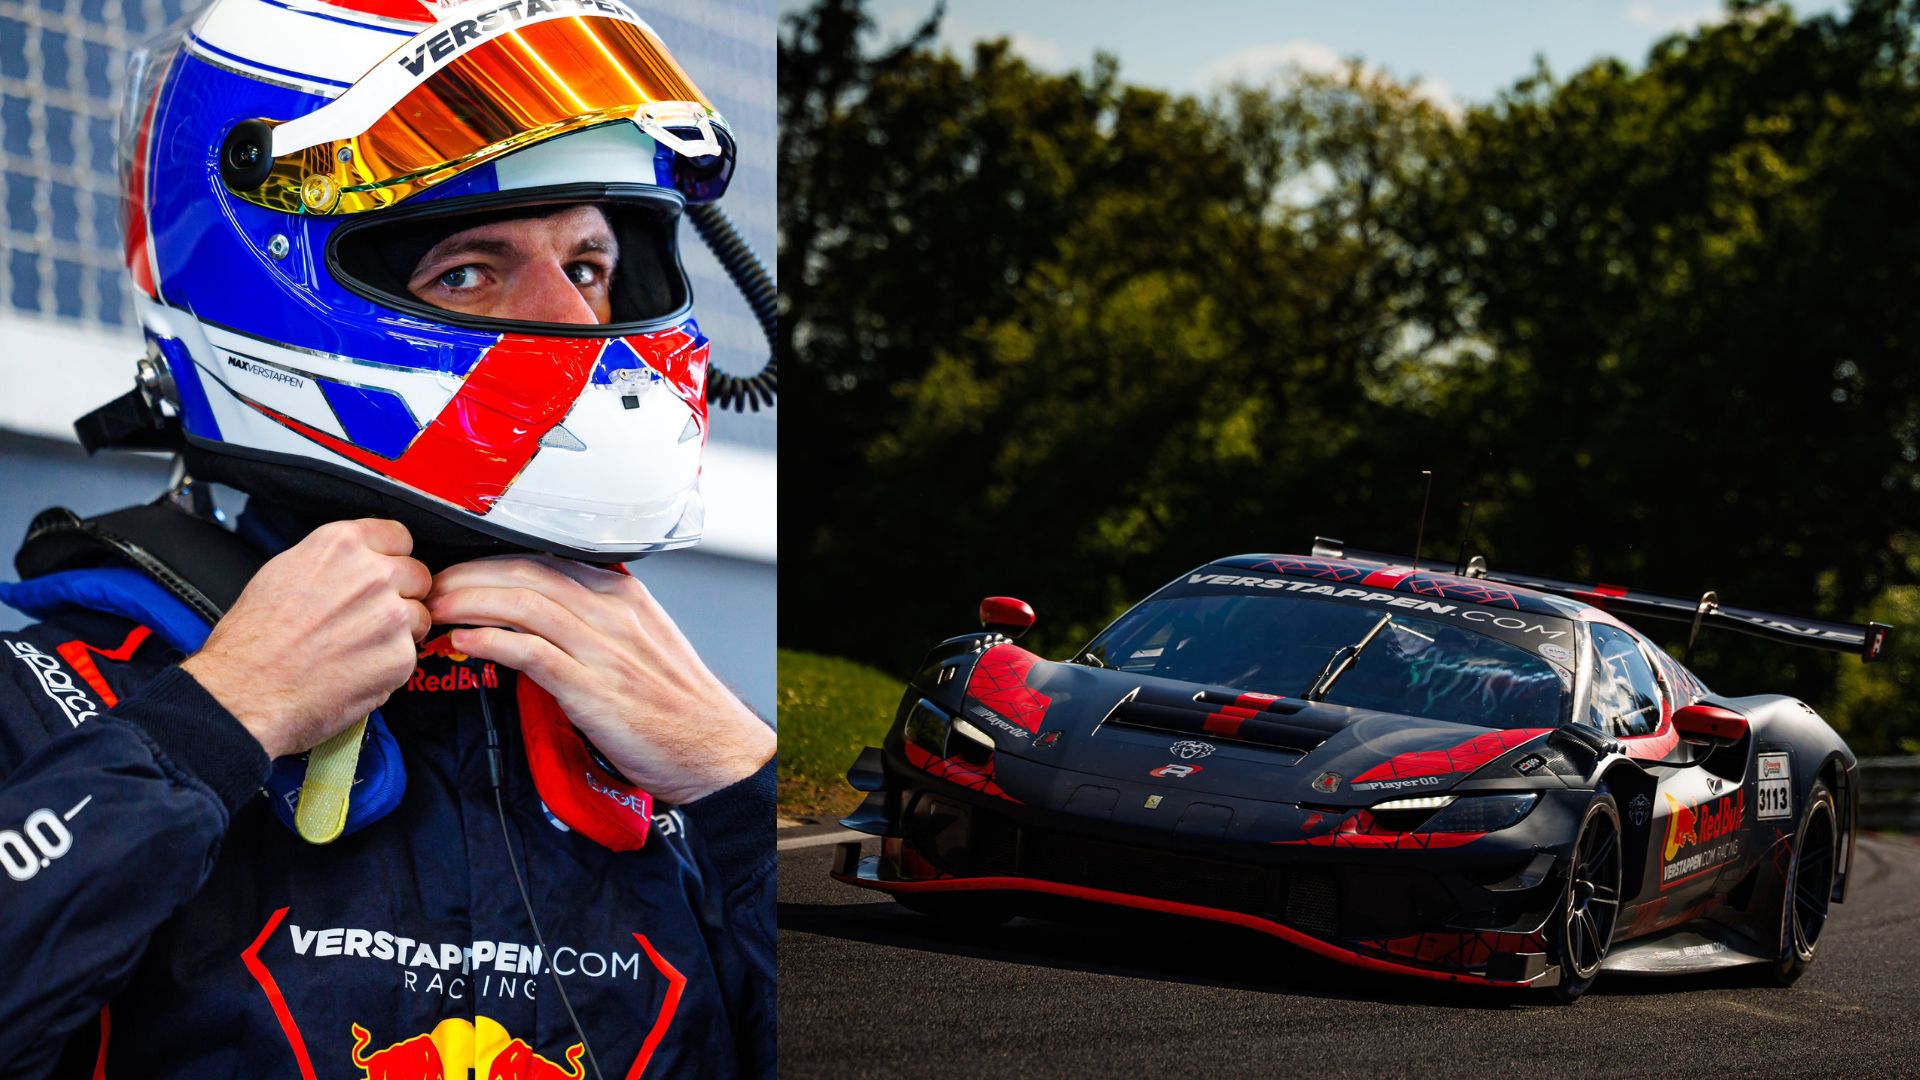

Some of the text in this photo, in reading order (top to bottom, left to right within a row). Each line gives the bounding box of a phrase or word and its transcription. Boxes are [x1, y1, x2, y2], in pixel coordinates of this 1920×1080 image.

[1187, 573, 1567, 640] VERSTAPPEN.COM
[1760, 787, 1788, 811] 3113
[404, 970, 536, 1000] RACING
